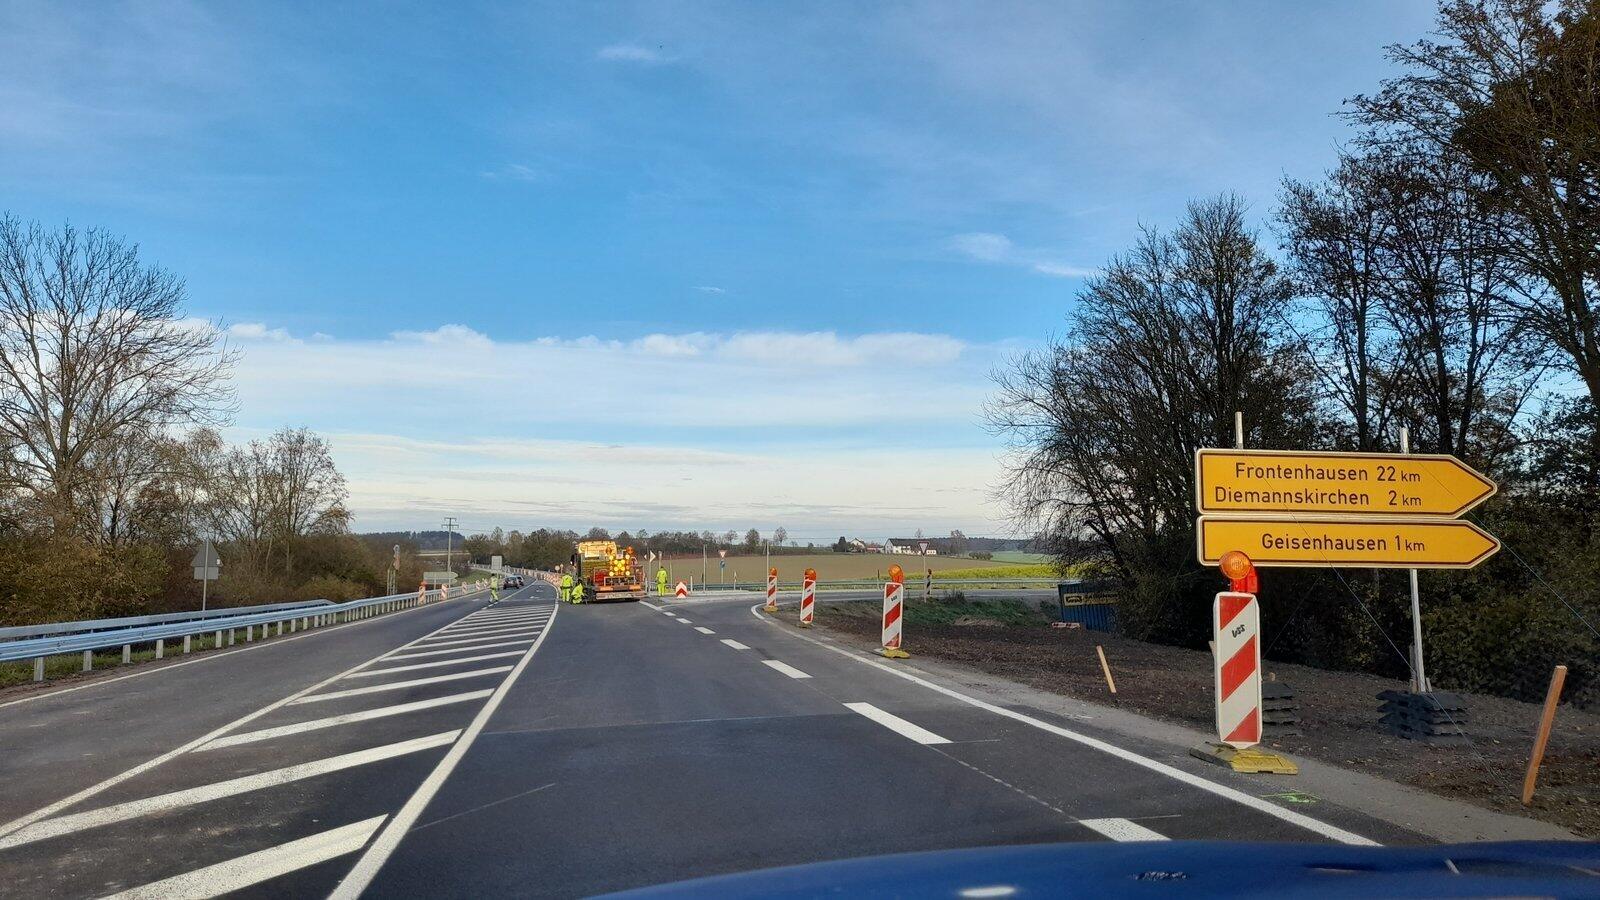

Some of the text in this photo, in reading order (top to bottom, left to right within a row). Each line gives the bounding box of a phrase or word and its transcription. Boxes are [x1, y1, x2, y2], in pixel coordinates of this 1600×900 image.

[1235, 462, 1421, 482] Frontenhausen 22 km
[1214, 486, 1422, 506] Diemannskirchen 2 km
[1261, 533, 1425, 552] Geisenhausen 1 km
